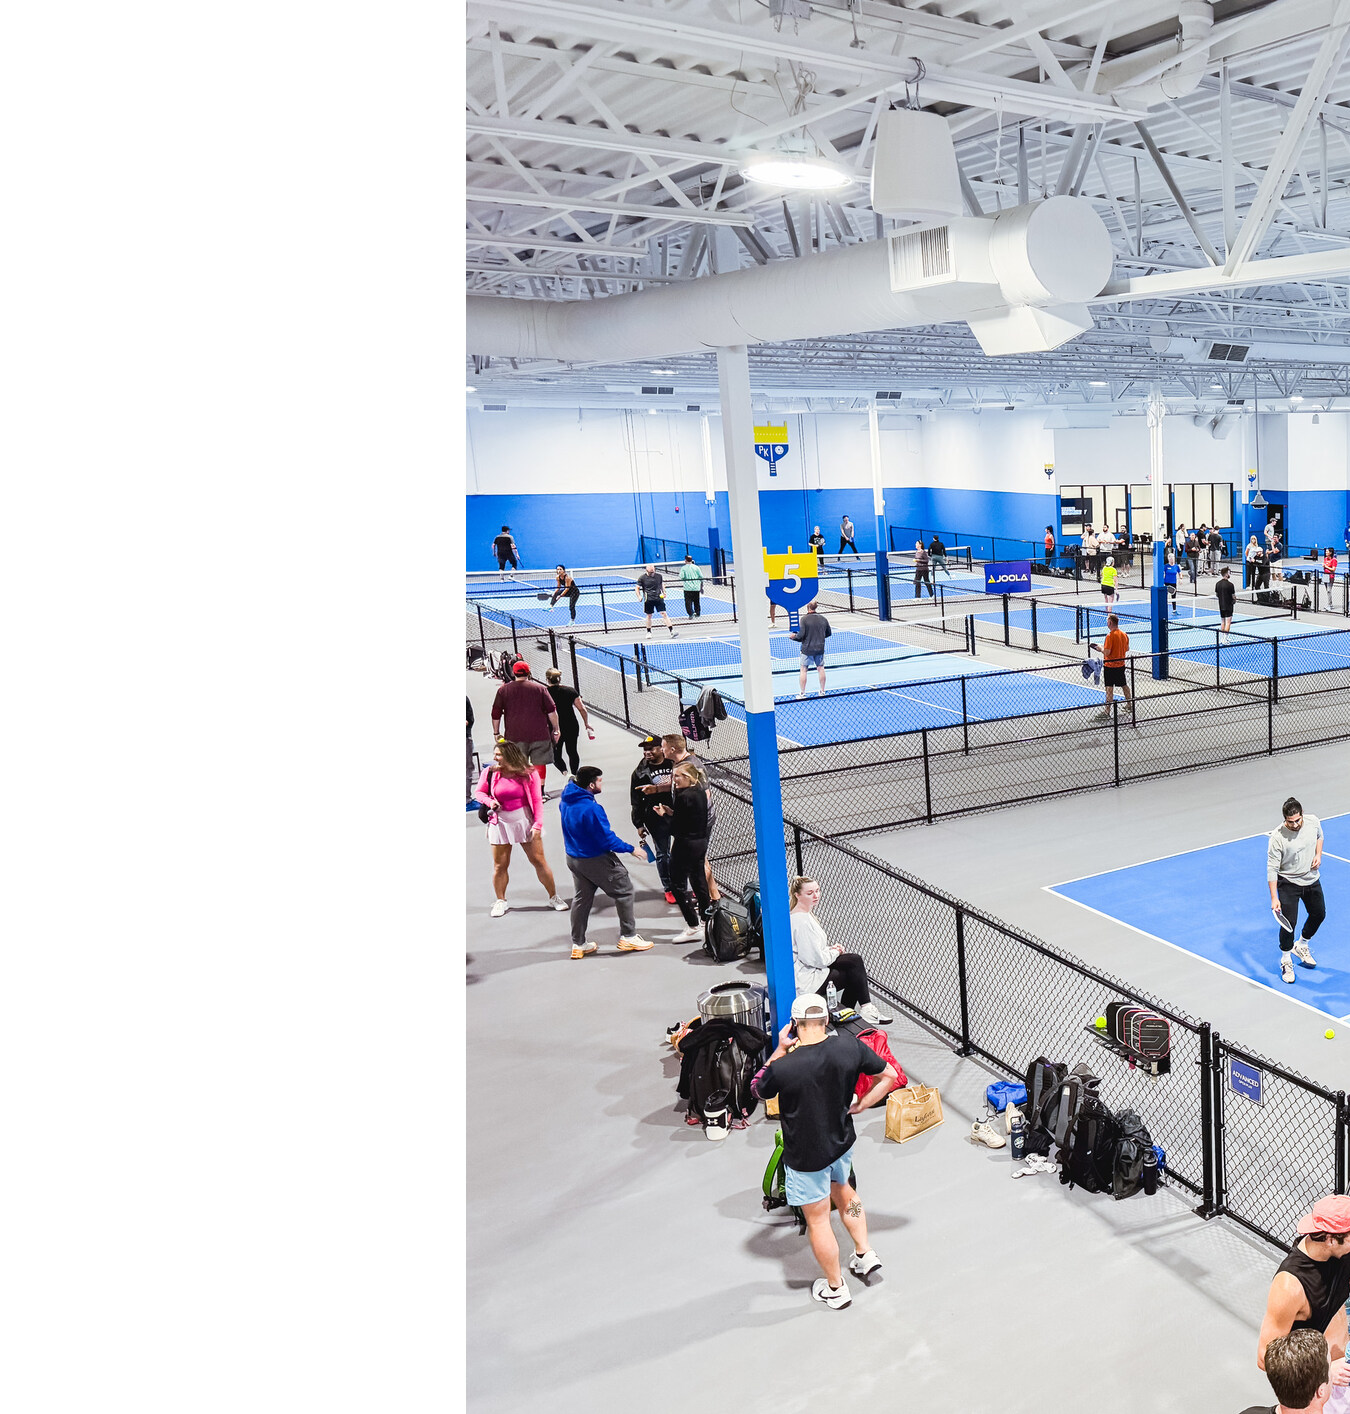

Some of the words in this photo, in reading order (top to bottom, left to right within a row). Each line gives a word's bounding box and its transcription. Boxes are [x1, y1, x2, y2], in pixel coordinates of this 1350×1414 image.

[782, 564, 802, 594] 5
[996, 574, 1028, 583] JOOLA
[1232, 1070, 1259, 1088] ADVANCED
